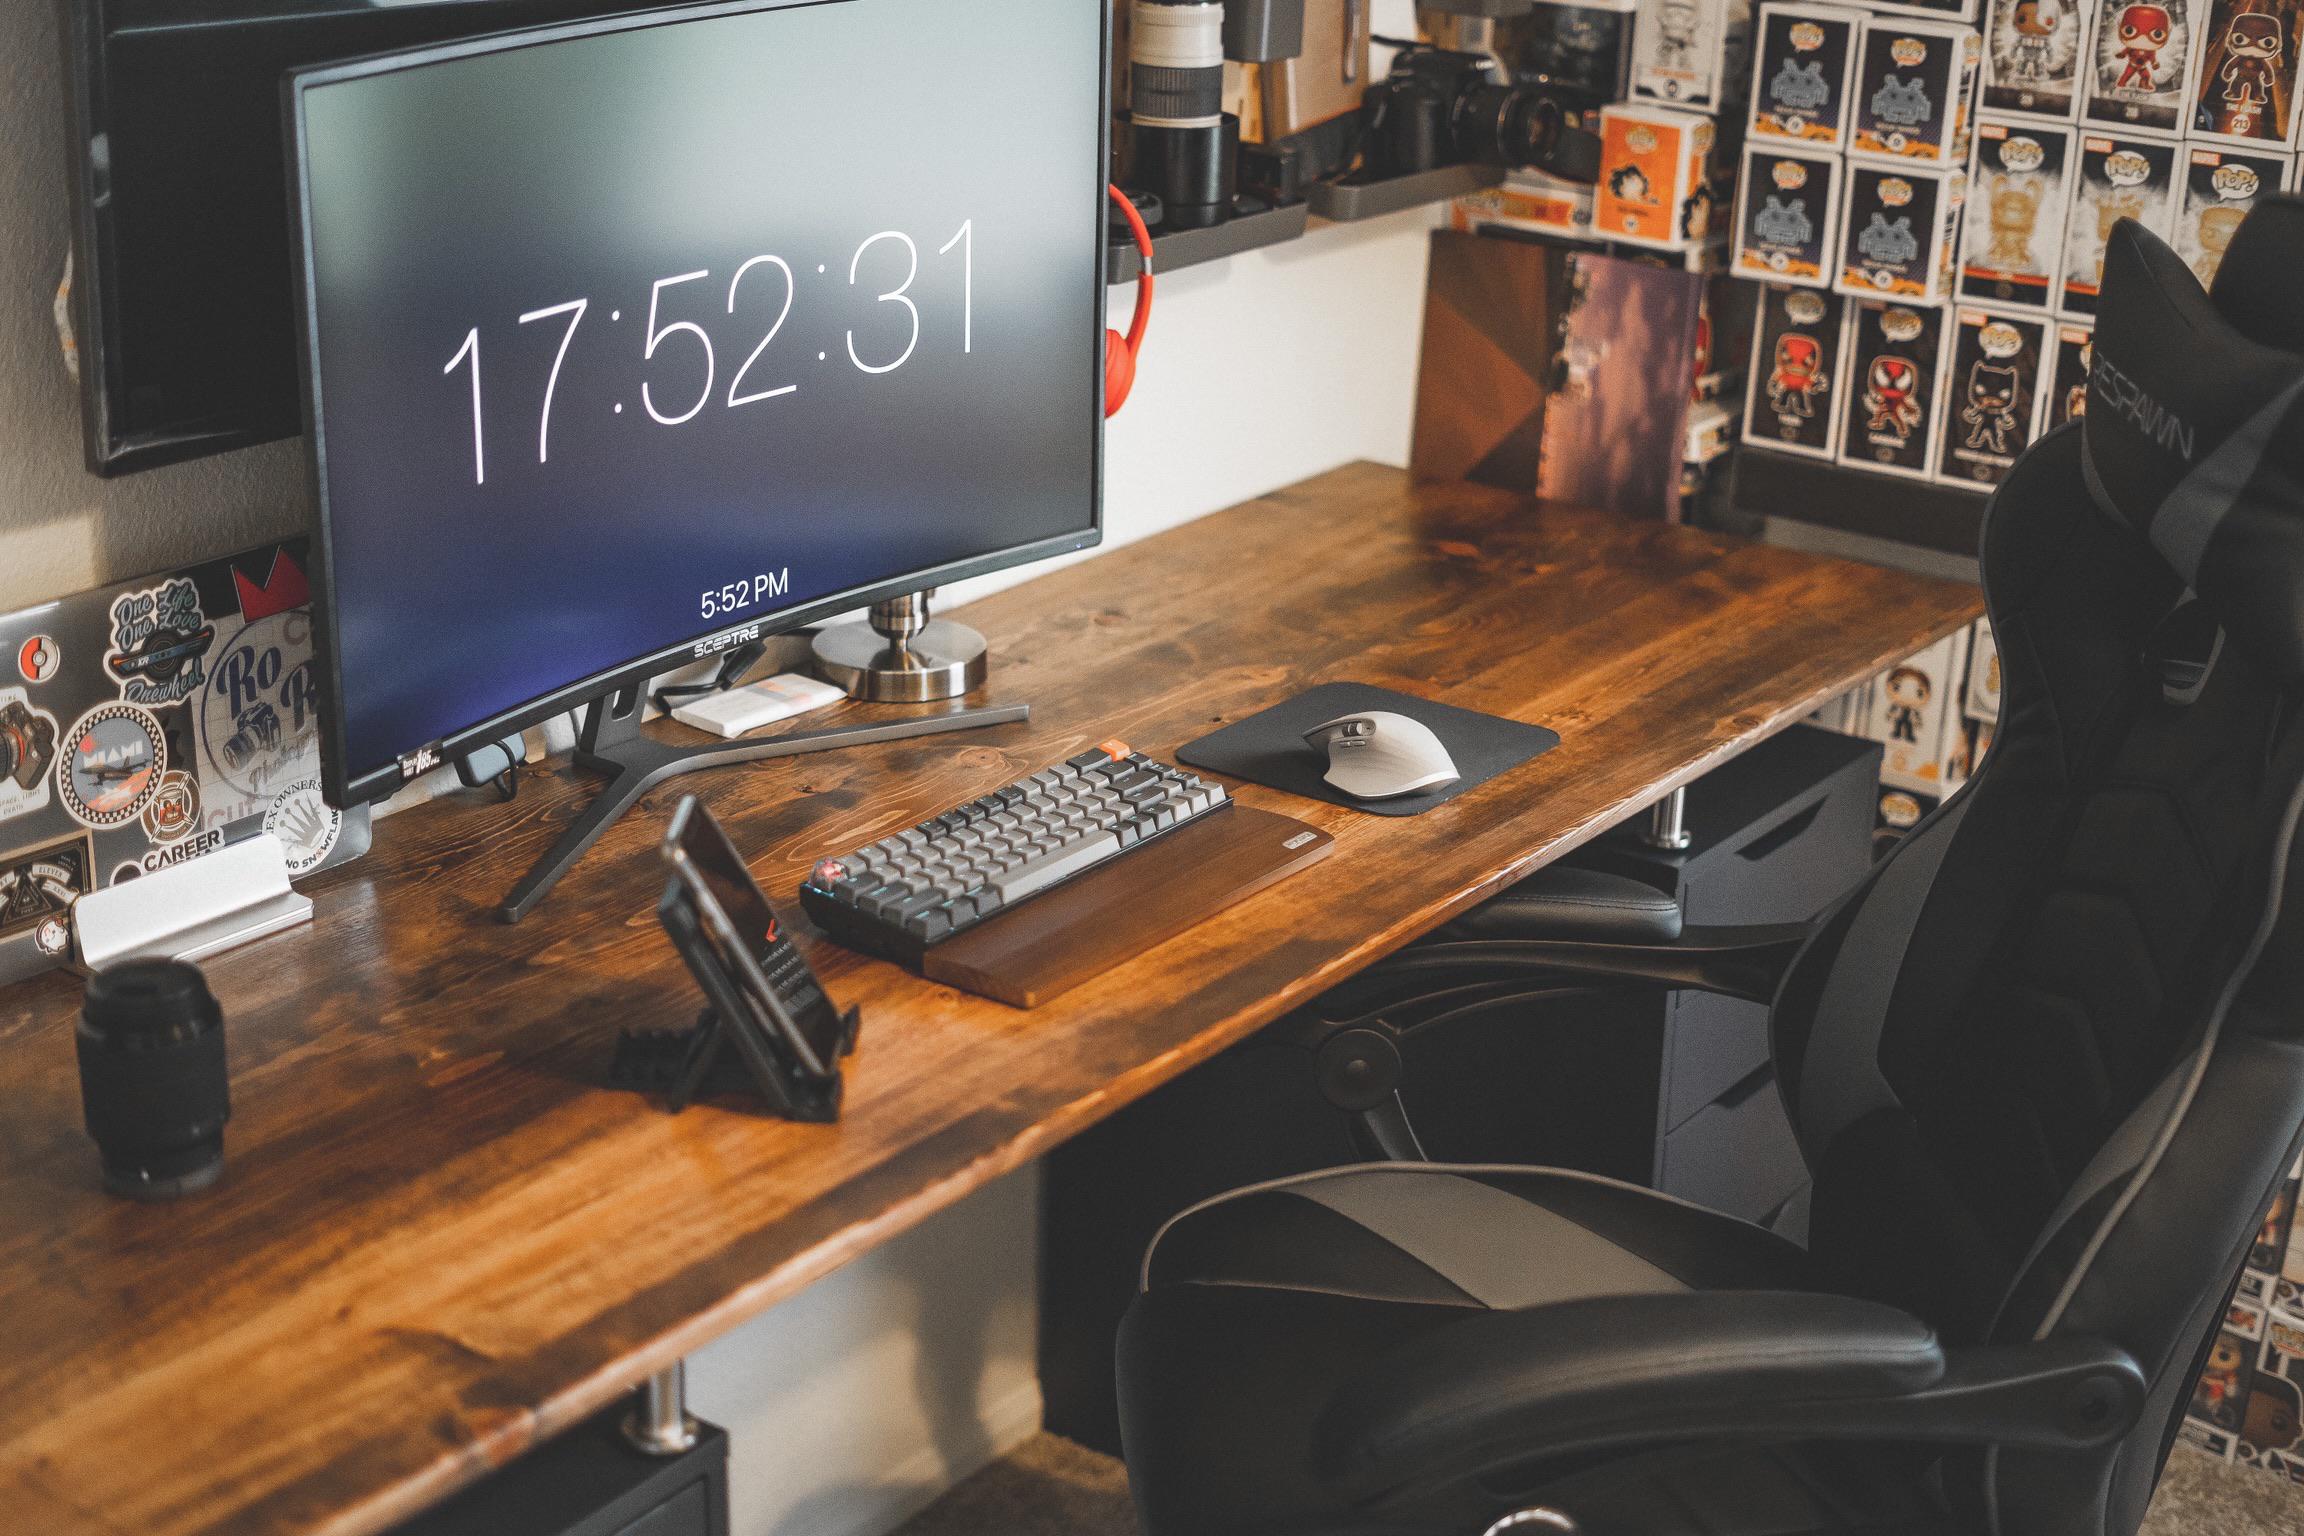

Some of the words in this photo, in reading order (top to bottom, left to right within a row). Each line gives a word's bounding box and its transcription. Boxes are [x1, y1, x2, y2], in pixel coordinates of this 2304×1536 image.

[2233, 118, 2249, 130] 213
[2214, 167, 2258, 192] POP!
[442, 218, 974, 486] 17:52:31
[116, 597, 152, 626] One
[158, 583, 195, 613] Life
[701, 580, 750, 619] 5:52
[754, 567, 788, 602] PM
[117, 620, 153, 651] One
[159, 605, 199, 629] Love
[694, 624, 759, 658] SCEPTRE
[125, 656, 204, 702] Onewheel
[83, 740, 143, 768] MIAMI
[144, 830, 220, 872] CAREER
[285, 859, 300, 869] NO
[302, 808, 339, 868] SNWFLAK
